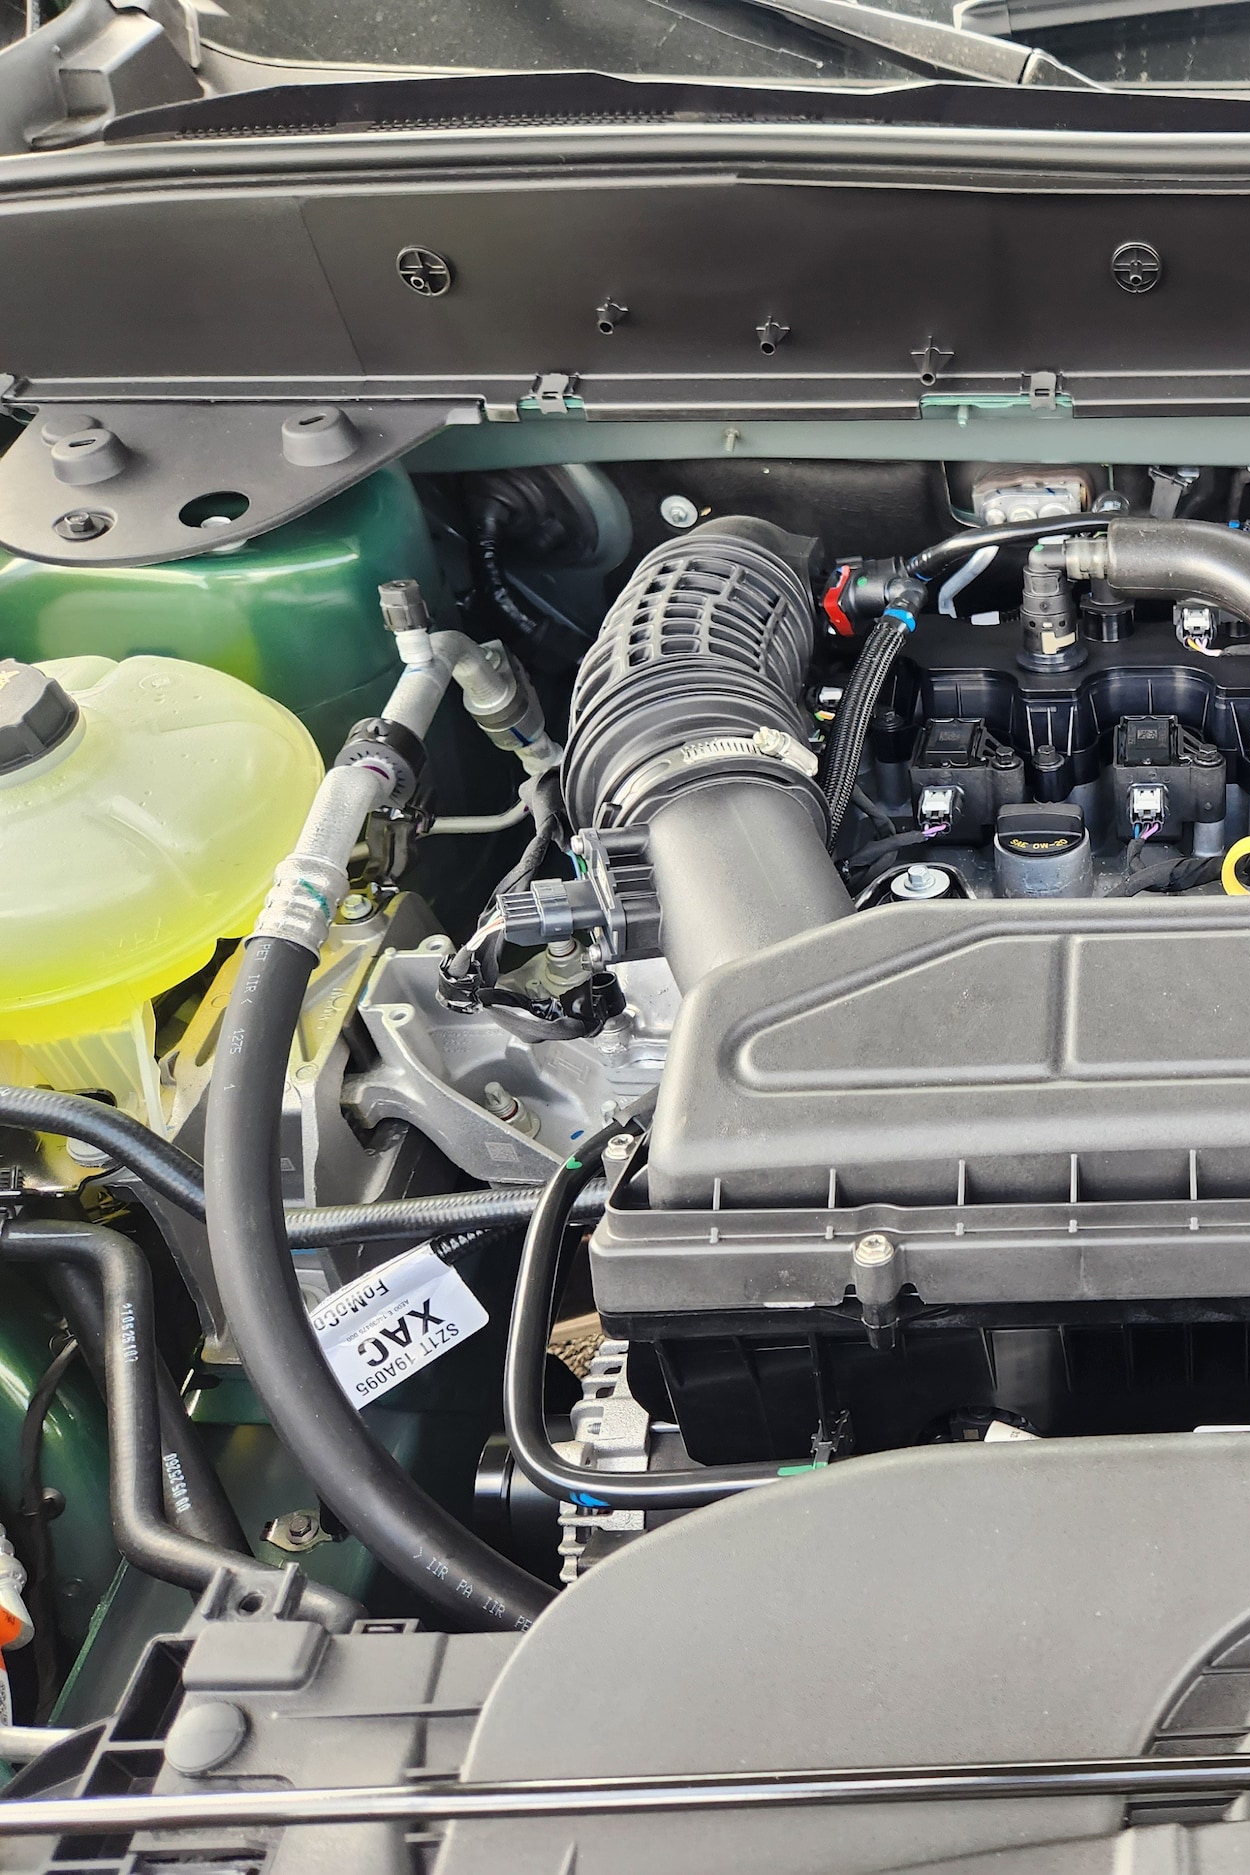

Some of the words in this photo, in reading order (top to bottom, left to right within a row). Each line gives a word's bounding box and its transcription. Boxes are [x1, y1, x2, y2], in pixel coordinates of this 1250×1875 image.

[1009, 838, 1029, 848] SAE
[255, 943, 272, 962] PET
[313, 1279, 390, 1331] FoMoCo
[357, 1298, 446, 1367] XAC
[423, 1322, 460, 1357] SZ1T
[355, 1352, 416, 1397] 19A095
[456, 1578, 473, 1599] PA
